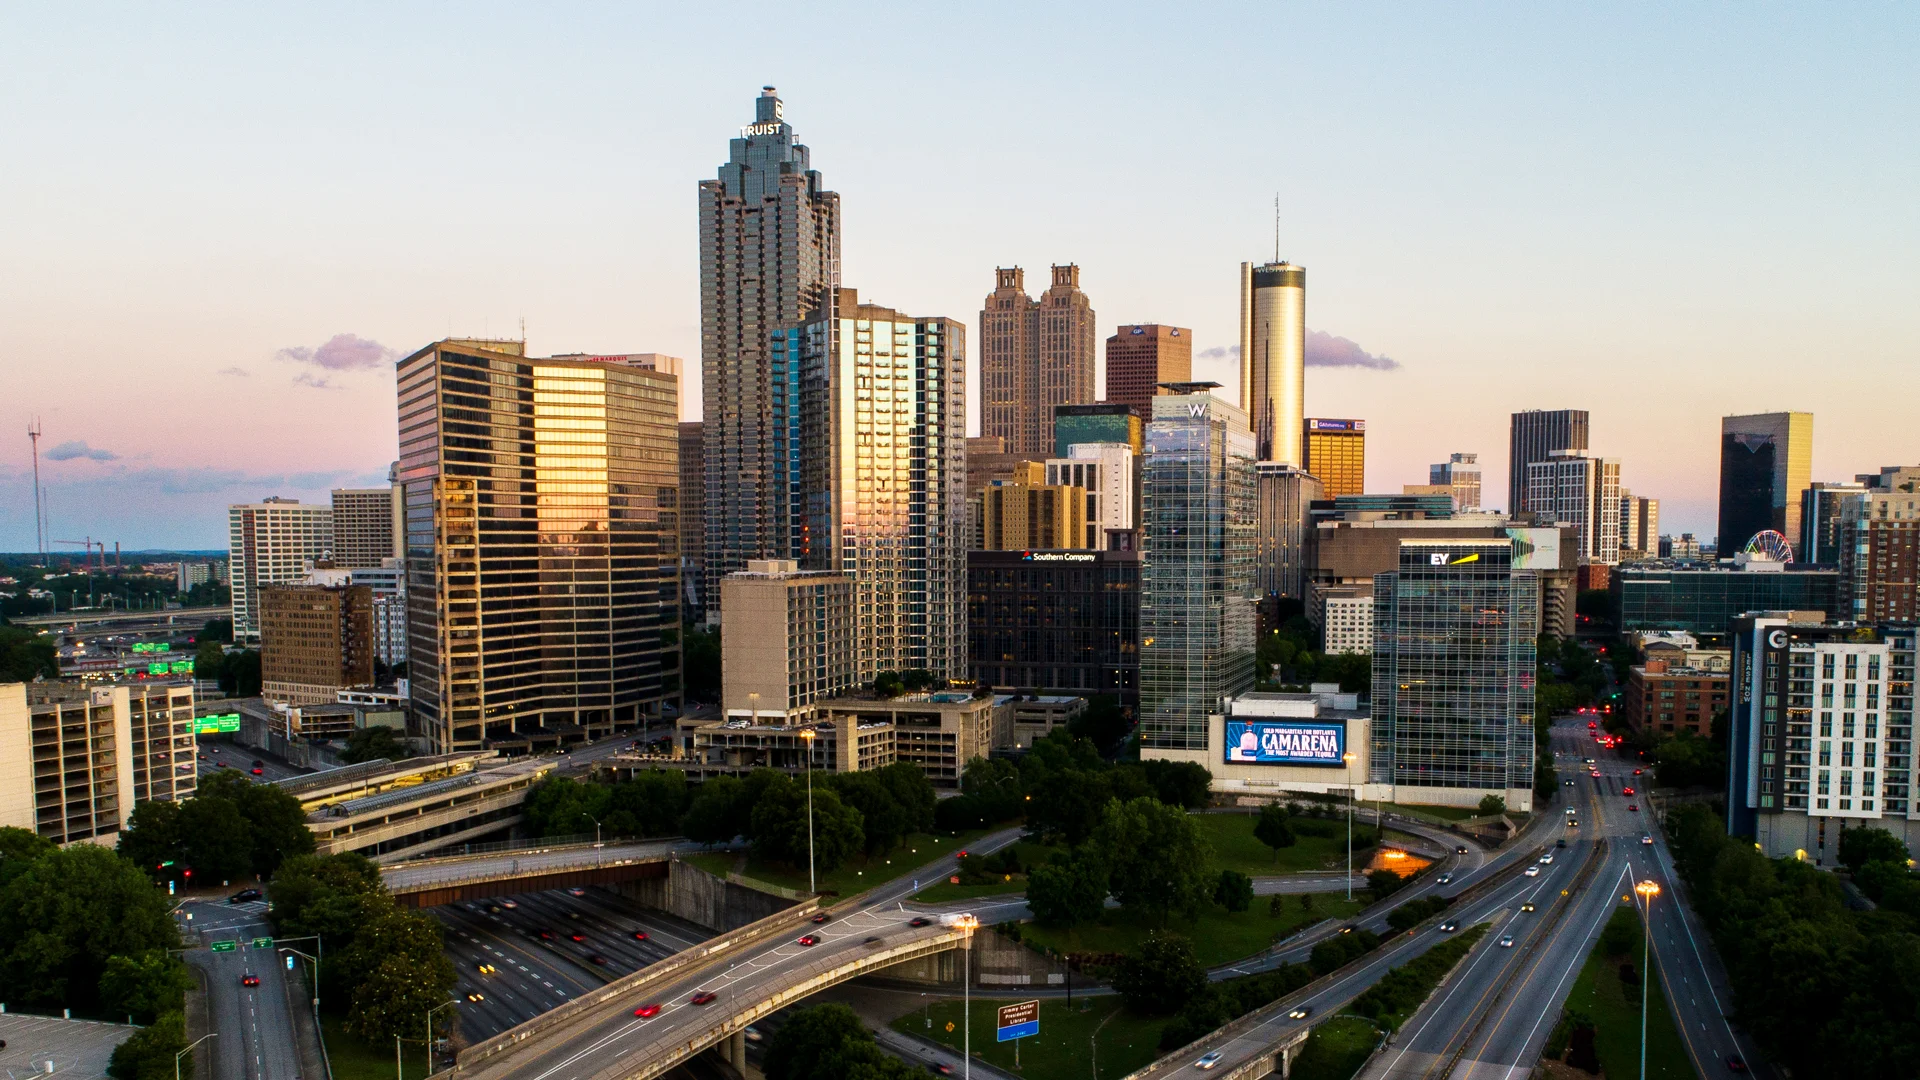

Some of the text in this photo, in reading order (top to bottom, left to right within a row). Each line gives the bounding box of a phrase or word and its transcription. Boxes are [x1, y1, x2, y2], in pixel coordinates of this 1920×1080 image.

[740, 124, 781, 138] TRUIST
[1187, 403, 1208, 418] W
[1033, 552, 1095, 562] Southern Company
[1431, 553, 1449, 565] EY
[1768, 629, 1788, 649] G
[1262, 734, 1338, 752] CAMARENA
[1314, 750, 1335, 758] TEQUILA
[1005, 1010, 1033, 1019] Presidential
